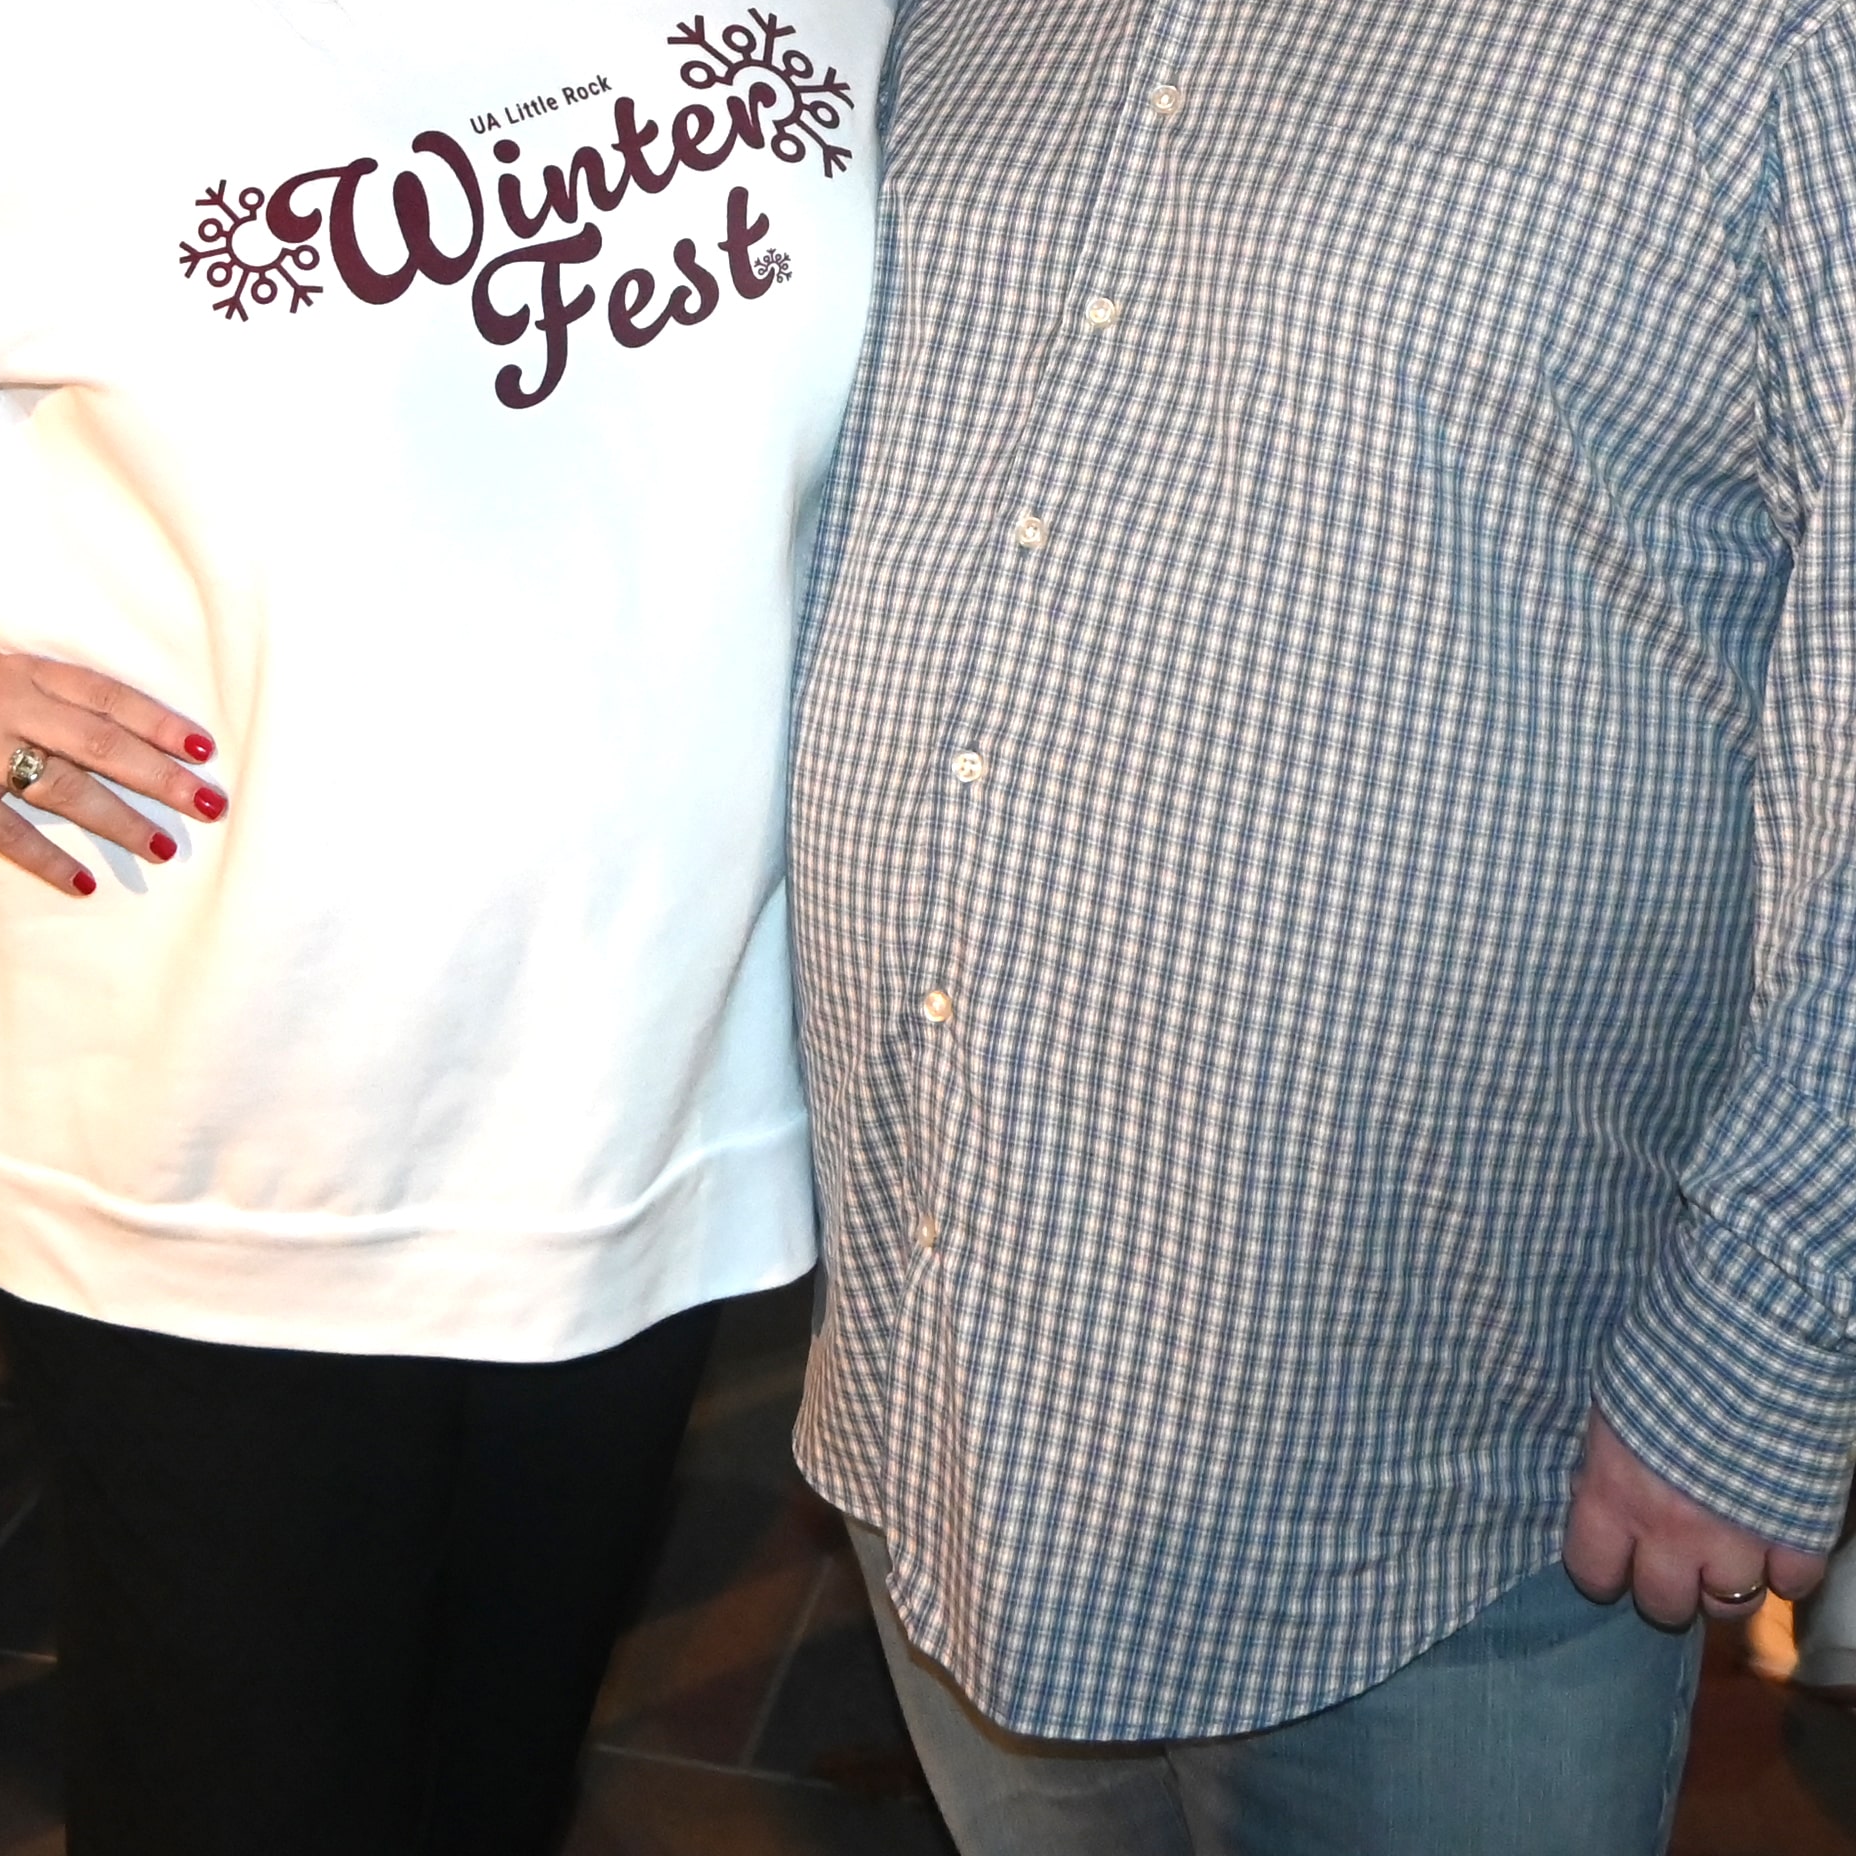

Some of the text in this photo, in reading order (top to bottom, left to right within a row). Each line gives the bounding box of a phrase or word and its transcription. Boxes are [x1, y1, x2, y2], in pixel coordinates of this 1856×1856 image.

[264, 80, 778, 306] Winter
[469, 74, 613, 134] UA Little Rock
[471, 186, 776, 411] Fest
